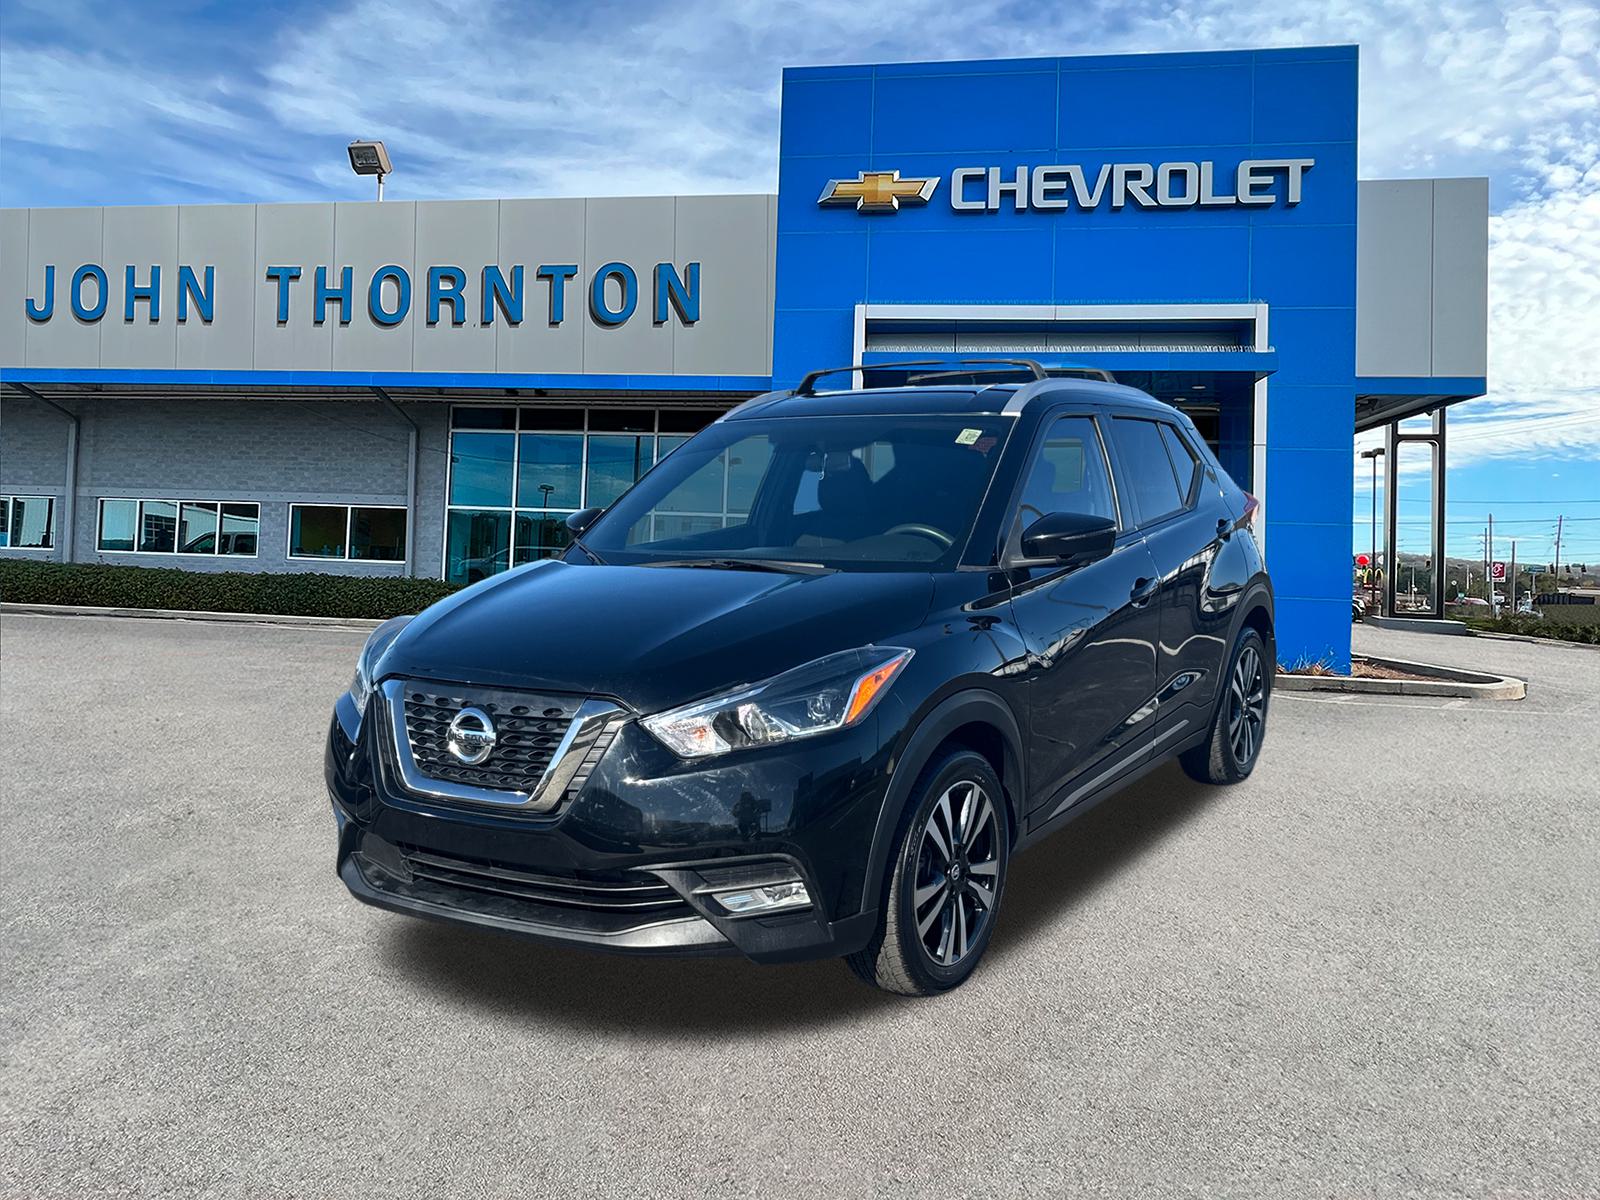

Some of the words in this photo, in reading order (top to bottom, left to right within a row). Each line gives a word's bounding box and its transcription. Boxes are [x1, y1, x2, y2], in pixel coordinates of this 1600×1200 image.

[950, 158, 1316, 211] CHEVROLET
[25, 264, 214, 323] JOHN
[265, 261, 701, 328] THORNTON
[448, 729, 489, 745] NISSAN
